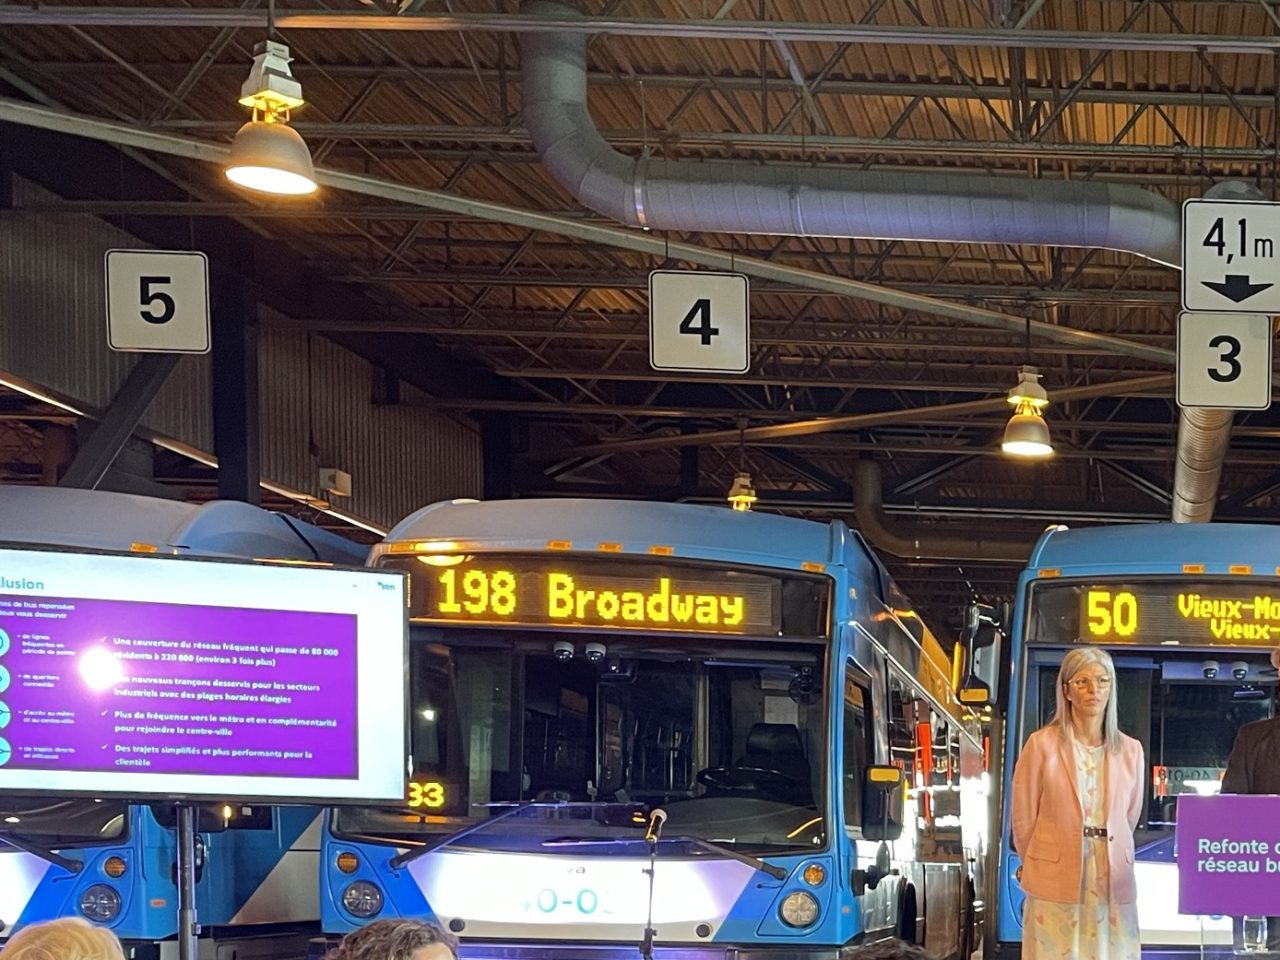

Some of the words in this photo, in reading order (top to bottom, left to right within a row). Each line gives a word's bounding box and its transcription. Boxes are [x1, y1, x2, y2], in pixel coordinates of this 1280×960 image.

[140, 276, 175, 324] 5
[679, 298, 719, 345] 4
[1207, 335, 1242, 383] 3
[0, 576, 44, 590] lusion
[438, 569, 516, 615] 198
[549, 573, 744, 625] Broadway
[1088, 591, 1138, 636] 50
[1198, 838, 1268, 854] Refonte
[1198, 857, 1259, 872] réseau
